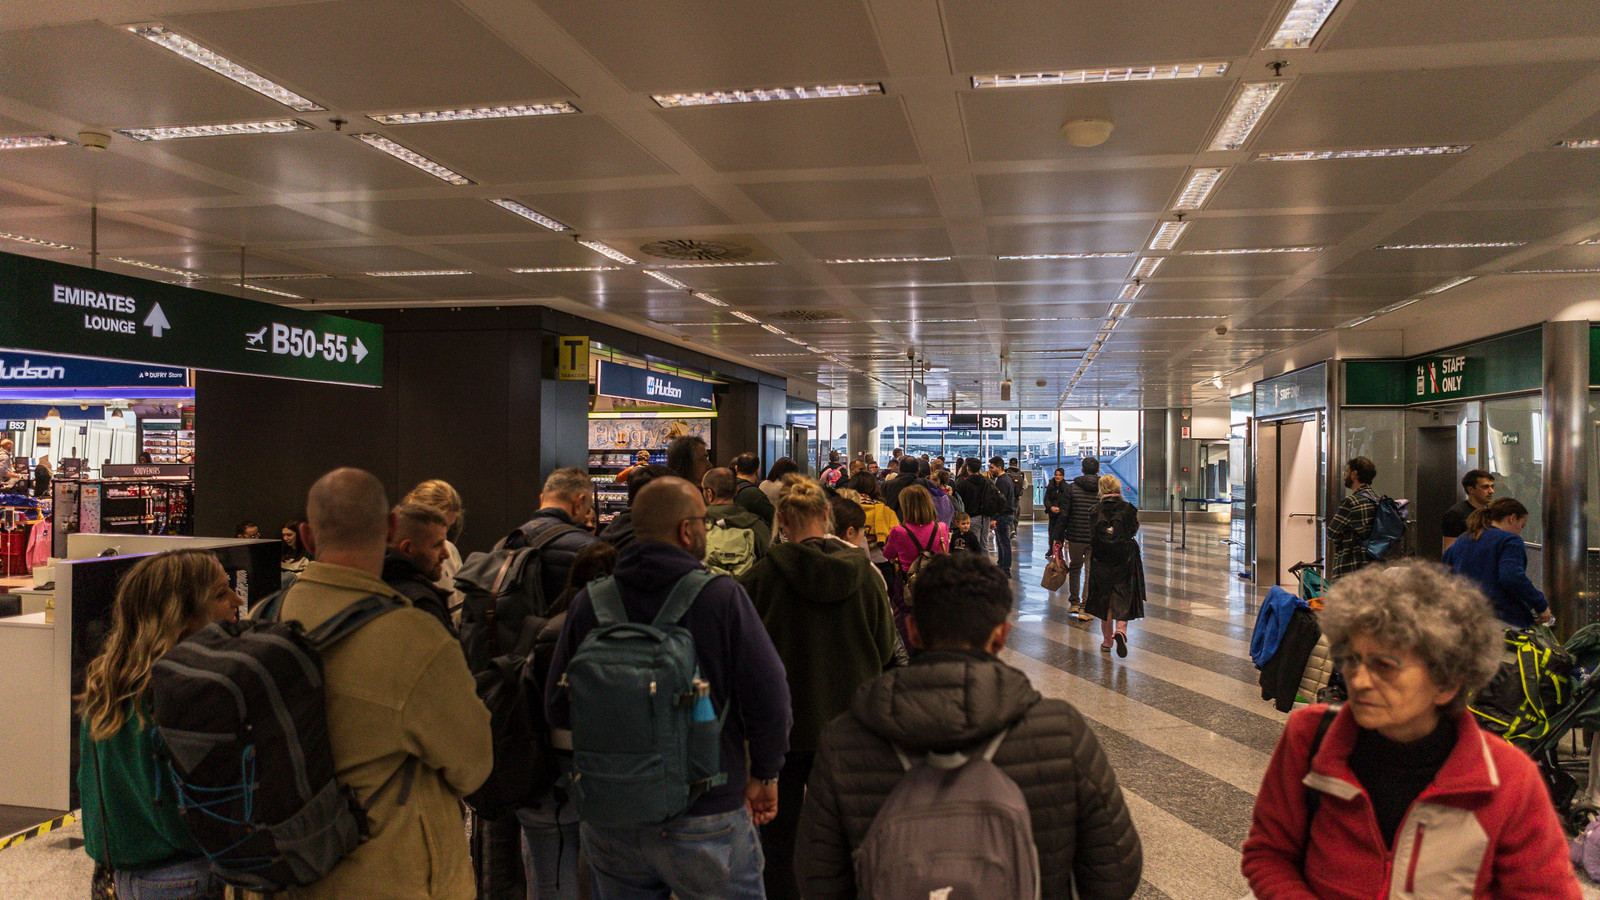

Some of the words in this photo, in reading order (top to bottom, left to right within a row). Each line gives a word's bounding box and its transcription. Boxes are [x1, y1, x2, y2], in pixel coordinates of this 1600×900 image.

[53, 283, 136, 314] EMIRATES
[84, 314, 136, 335] LOUNGE
[271, 322, 348, 363] B50-55
[564, 340, 583, 370] T
[1442, 355, 1466, 375] STAFF
[654, 378, 682, 399] Hudson
[1442, 375, 1463, 393] ONLY
[9, 421, 25, 430] B52
[982, 417, 1004, 428] B51
[133, 466, 161, 475] SOUVENIRS
